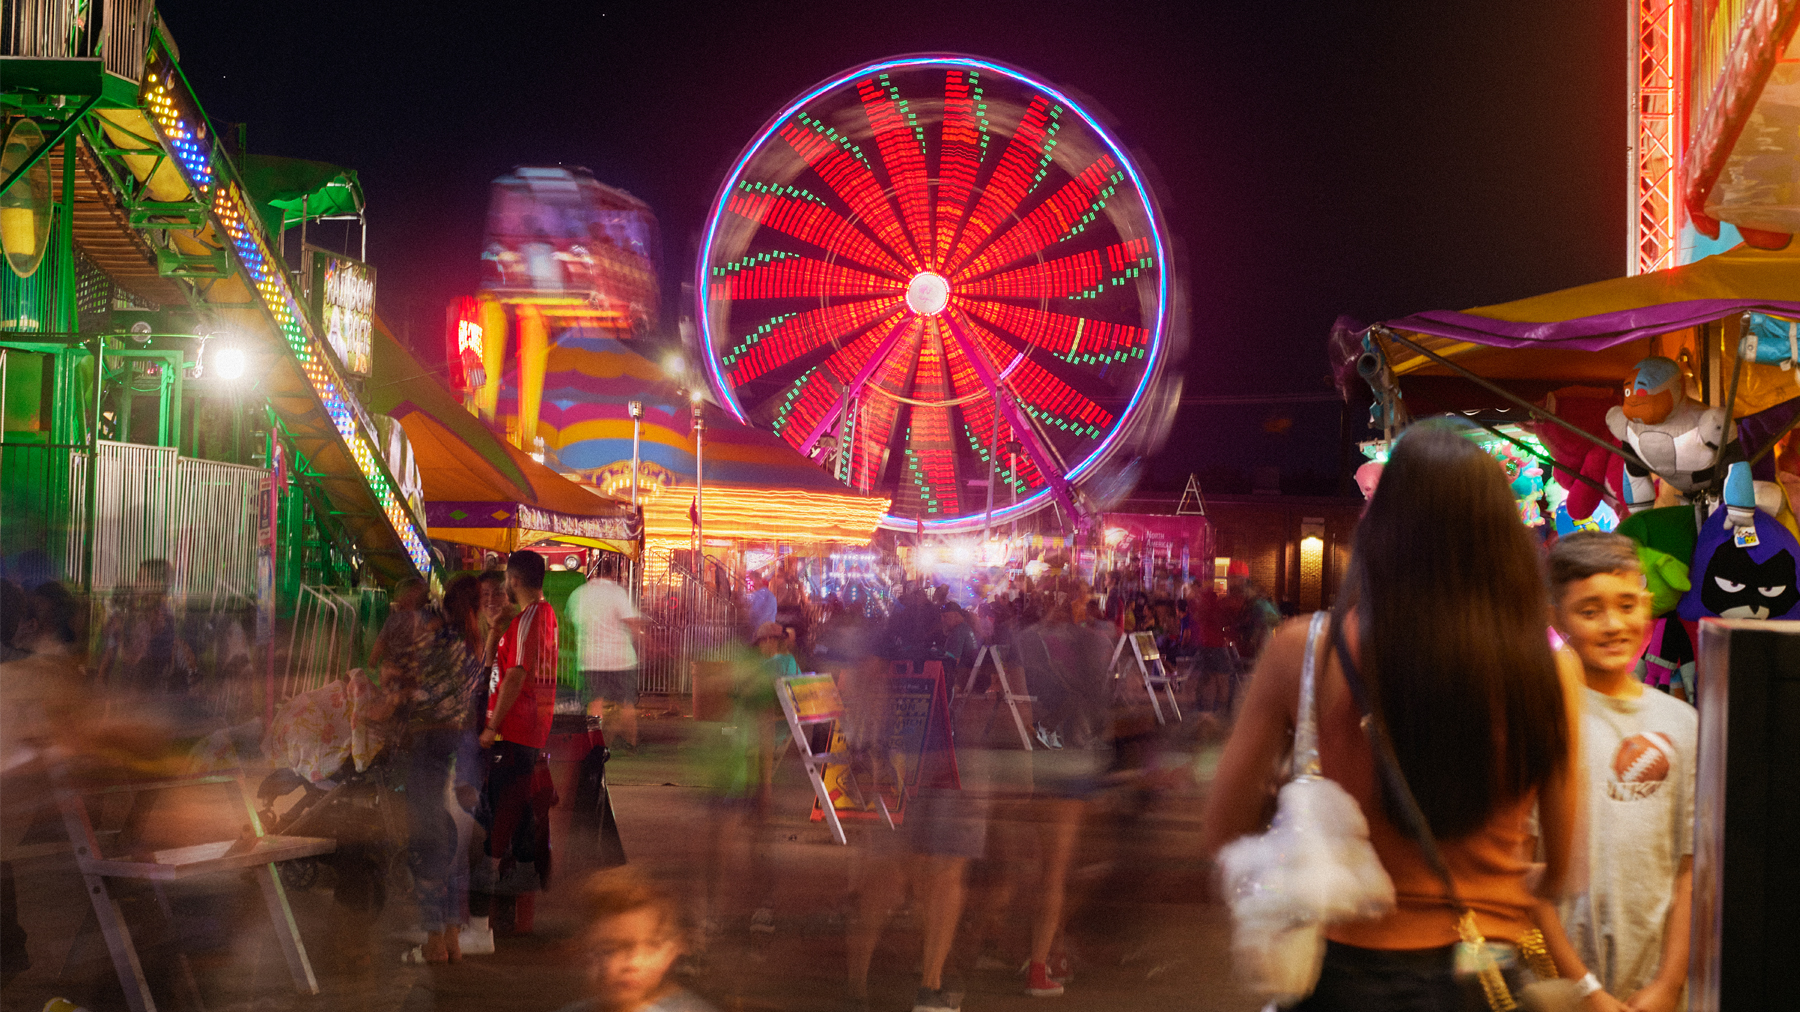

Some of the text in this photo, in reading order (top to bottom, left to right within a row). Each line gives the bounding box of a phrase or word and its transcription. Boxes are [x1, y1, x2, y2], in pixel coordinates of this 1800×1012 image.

[228, 179, 277, 273] Welcome
[314, 338, 350, 402] Jungle
[326, 268, 374, 315] RAINBOW
[347, 313, 371, 356] ROCK
